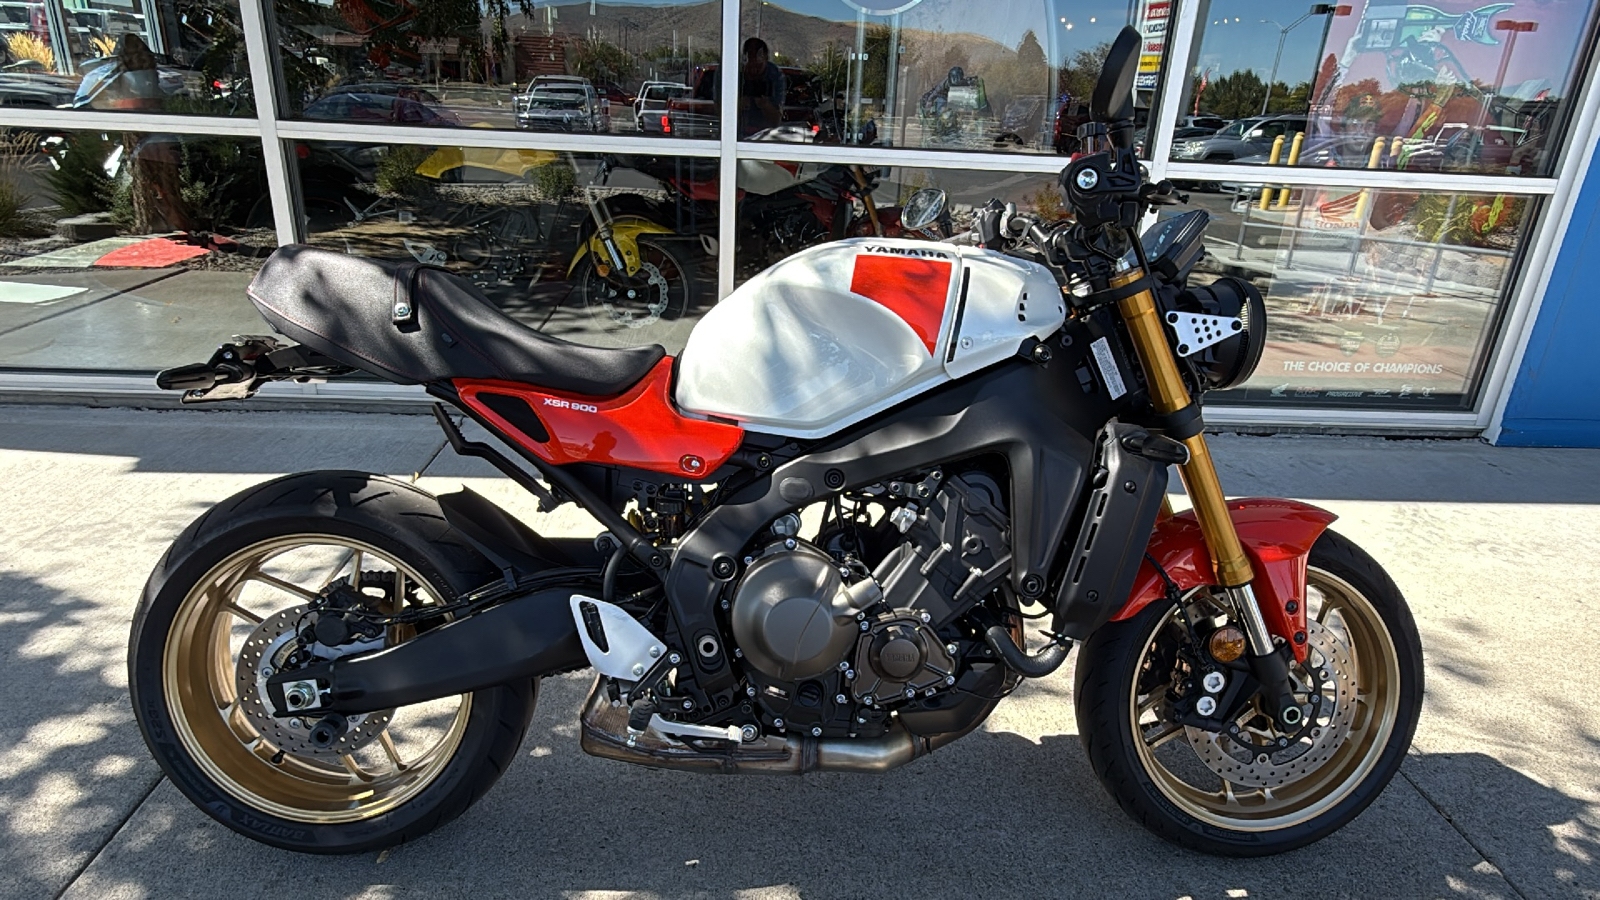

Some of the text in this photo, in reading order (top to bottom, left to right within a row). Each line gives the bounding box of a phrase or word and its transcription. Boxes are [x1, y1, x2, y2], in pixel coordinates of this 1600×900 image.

[865, 246, 948, 259] YAMAHA
[1283, 361, 1443, 374] THE CHOICE OF CHAMPIONS
[1325, 390, 1364, 398] PROGRESSIVE
[543, 397, 598, 413] XSR 900
